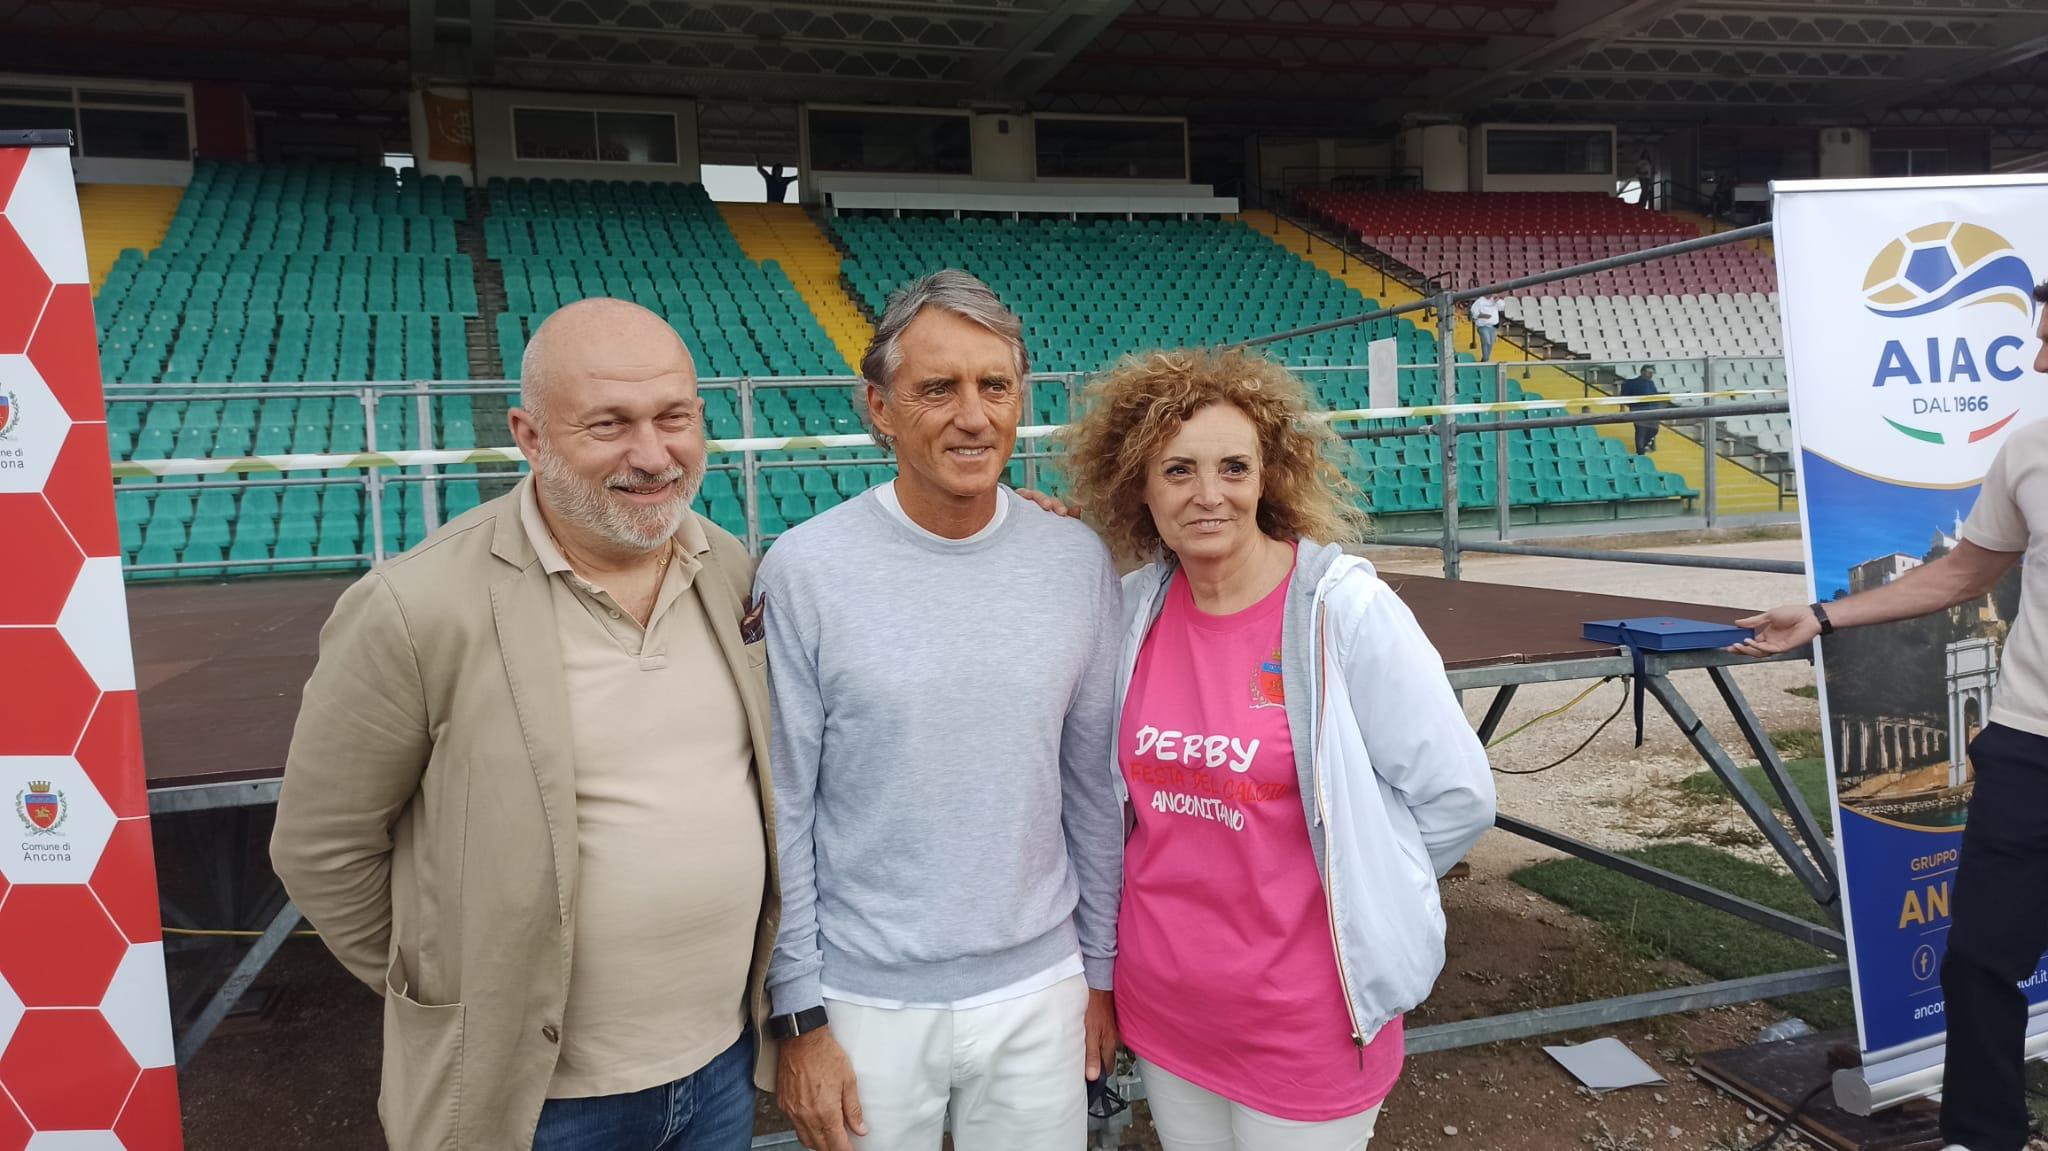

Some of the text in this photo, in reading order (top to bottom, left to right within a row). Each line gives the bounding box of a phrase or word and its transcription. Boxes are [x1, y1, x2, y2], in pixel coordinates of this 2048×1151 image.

[1872, 335, 2025, 387] AIAC
[1912, 395, 1989, 415] DAL 1966
[0, 460, 24, 469] ona
[1134, 725, 1260, 773] DERBY
[1130, 762, 1185, 786] FESTA
[1151, 790, 1245, 831] ANCONITANO
[21, 842, 71, 851] Comune di
[23, 852, 71, 862] Ancona
[1911, 848, 1958, 872] GRUPPO
[1899, 881, 1949, 928] AN
